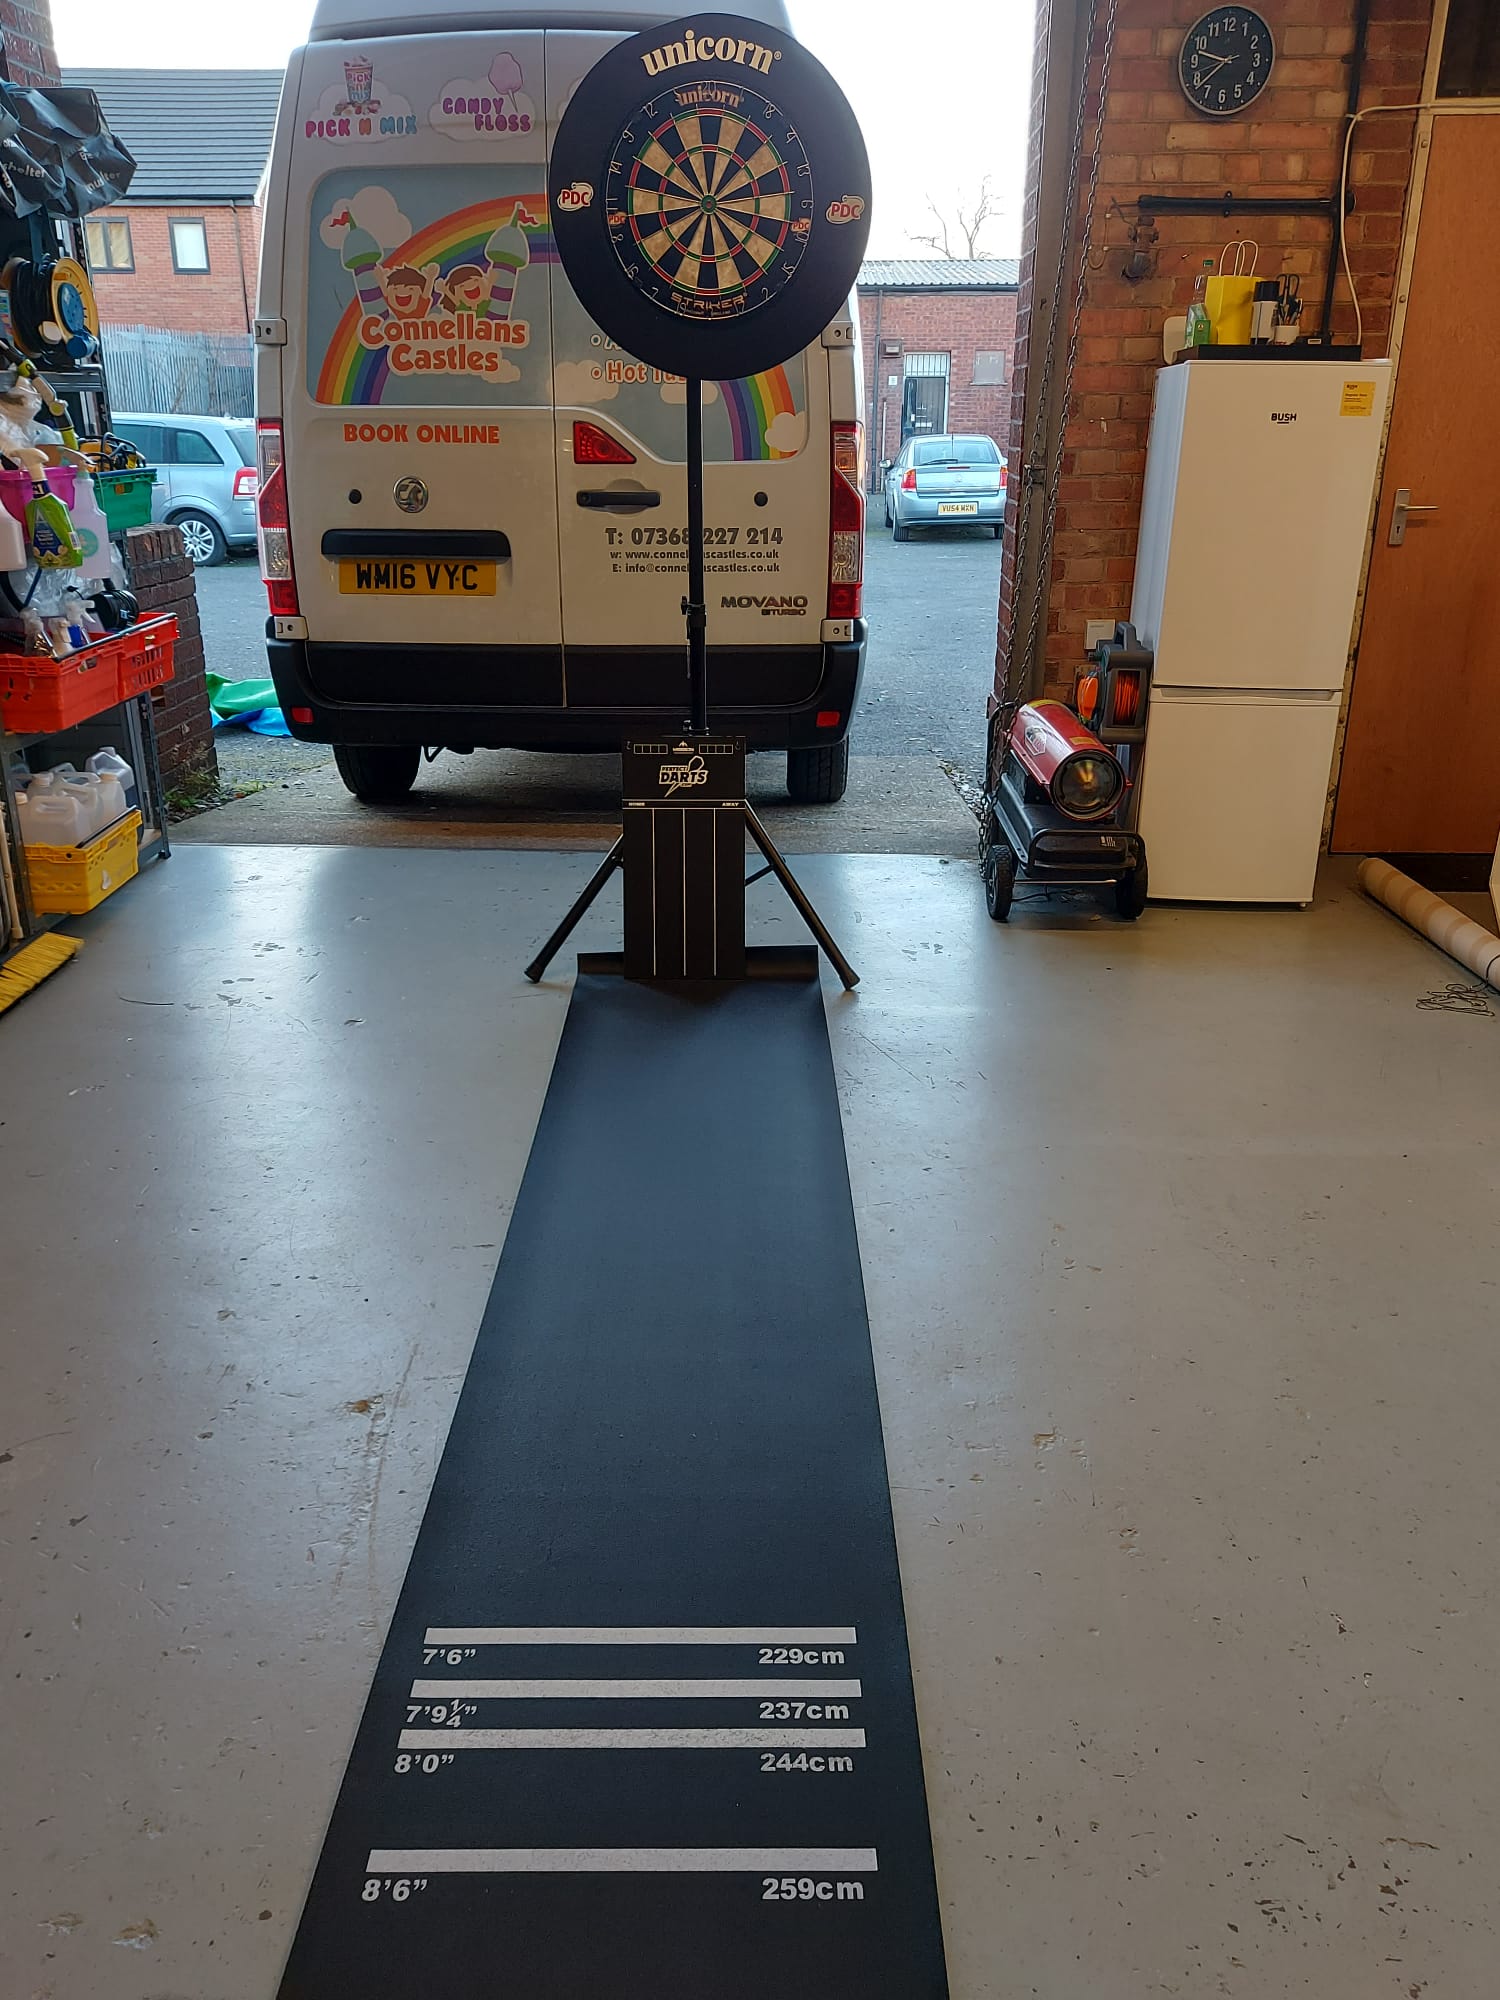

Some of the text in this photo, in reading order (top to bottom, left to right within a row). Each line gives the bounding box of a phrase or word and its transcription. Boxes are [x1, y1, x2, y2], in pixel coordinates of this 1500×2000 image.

[1208, 22, 1219, 37] 11
[1223, 17, 1236, 32] 12
[1242, 22, 1248, 36] 1
[1195, 35, 1207, 50] 10
[1251, 35, 1259, 49] 2
[1191, 54, 1198, 68] 9
[1253, 53, 1260, 67] 3
[1193, 71, 1201, 86] 8
[1247, 72, 1254, 85] 4
[1204, 85, 1211, 98] 7
[1218, 89, 1226, 103] 6
[1234, 84, 1242, 98] 5
[443, 97, 504, 114] CANDY
[306, 115, 417, 138] PICK N MIX
[475, 114, 531, 132] FLOSS
[561, 190, 589, 205] PDC
[831, 203, 860, 219] PDC
[361, 313, 525, 345] Connellans
[391, 344, 498, 372] Castles
[606, 361, 646, 382] Hot
[1271, 413, 1297, 421] BUSH
[344, 424, 500, 443] BOOK ONLINE
[605, 527, 783, 545] T: 07368 227 214
[626, 549, 779, 559] www.connelscastles.co.uk
[612, 563, 622, 572] E:
[356, 563, 478, 590] WM16 VYC
[721, 596, 808, 608] MOVANO
[661, 771, 706, 783] DARTS
[423, 1648, 845, 1665] 7'6" 229cm
[759, 1702, 849, 1720] 237cm
[394, 1753, 854, 1773] 8'0" 244cm
[361, 1878, 865, 1901] 8'6" 259cm
